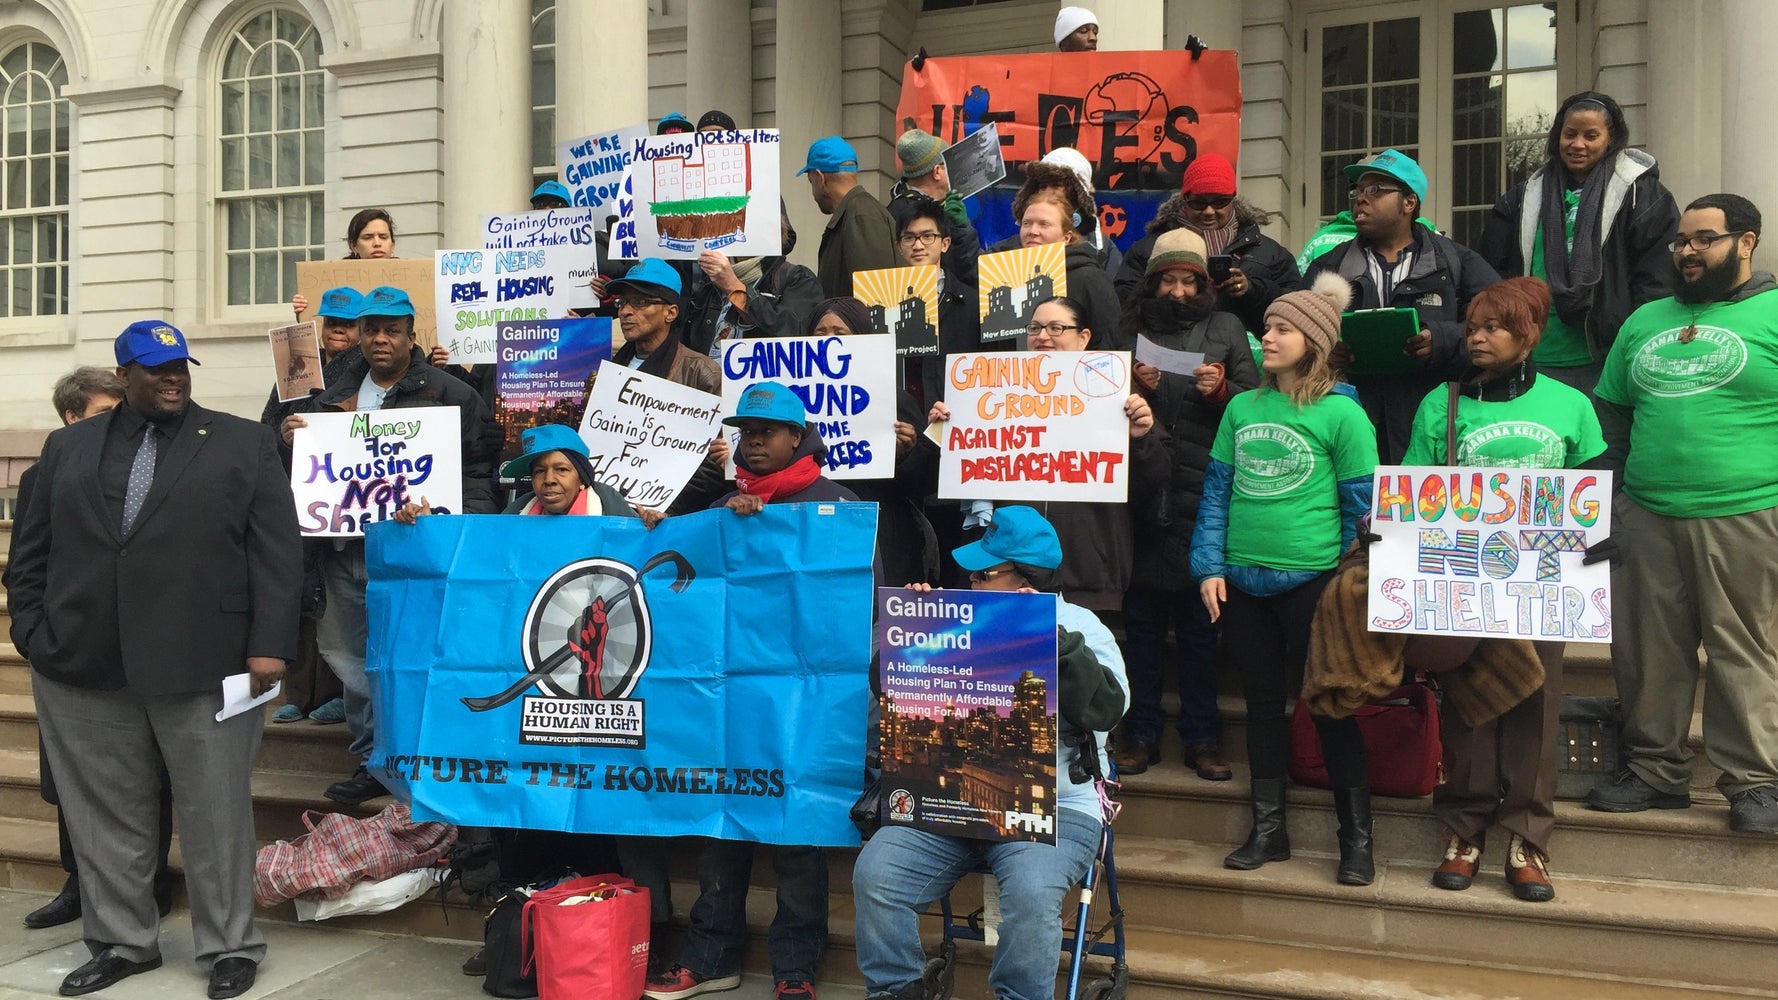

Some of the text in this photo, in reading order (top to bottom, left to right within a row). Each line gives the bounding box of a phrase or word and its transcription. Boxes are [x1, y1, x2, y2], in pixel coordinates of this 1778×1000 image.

[570, 134, 621, 159] WE'RE
[633, 129, 779, 161] Housing not Shelters
[566, 150, 631, 186] GAINING
[488, 208, 592, 237] Gaining Ground
[570, 224, 593, 245] US
[616, 220, 636, 240] BU
[622, 240, 638, 258] NO
[441, 250, 545, 275] NYC NEEDS
[303, 268, 370, 290] SAFETY
[451, 275, 554, 303] REAL HOUSING
[455, 307, 547, 331] SOLUTIONS
[502, 325, 560, 342] Gaining
[983, 328, 1026, 341] New Econo
[502, 346, 558, 362] Ground
[724, 337, 852, 380] GAINING
[896, 345, 937, 356] my Project
[501, 371, 558, 380] A Homeless-Led
[501, 380, 585, 390] Housing Plan To Ensure
[950, 354, 1061, 394] GAINING
[501, 390, 583, 400] Permanently Affordable
[501, 401, 531, 409] Housing
[545, 400, 555, 408] All
[618, 376, 720, 425] Empowerment
[977, 392, 1085, 420] GROUND
[350, 413, 421, 439] Money
[590, 410, 648, 445] Gaining
[652, 425, 712, 455] Ground
[643, 413, 655, 429] is
[818, 421, 850, 439] OME
[364, 437, 406, 457] For
[949, 425, 1047, 452] AGAINST
[620, 443, 648, 468] For
[825, 440, 872, 472] KERS
[961, 451, 1123, 484] DISPLACEMENT
[303, 453, 433, 485] Housing
[341, 474, 411, 510] Not
[1376, 472, 1600, 527] HOUSING
[1418, 527, 1588, 582] NOT
[886, 596, 973, 624] Gaining
[1372, 578, 1611, 638] SHELTERS
[886, 626, 971, 650] Ground
[887, 662, 973, 676] A Homeless-Led
[887, 675, 1015, 693] Housing Plan To Ensure
[530, 701, 637, 716] HOUSING IS A
[887, 689, 1012, 707] Permanently Affordable
[887, 702, 969, 718] Housing For All
[524, 715, 640, 731] HUMAN RIGHT
[525, 734, 639, 745] WWW.PICTURETHEHOMELESS.ORG
[384, 755, 786, 798] ICTURE THE HOMELESS
[1005, 811, 1053, 834] PTH
